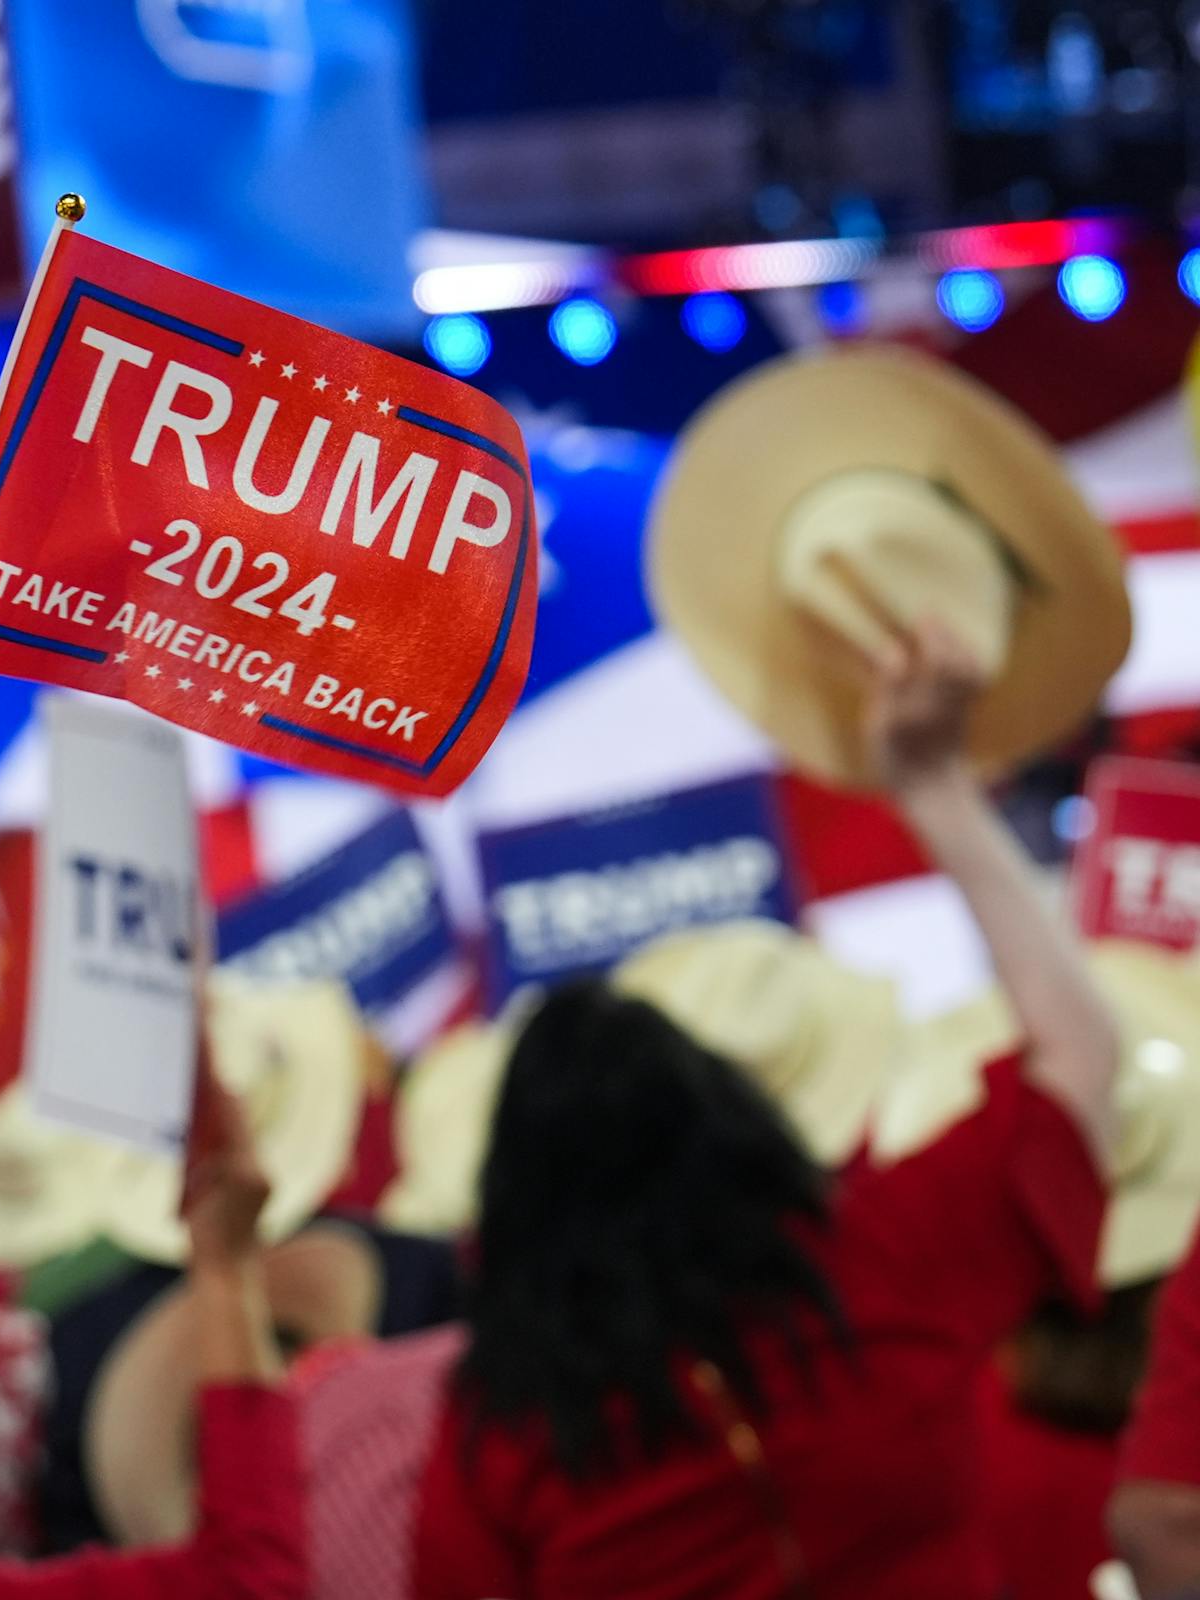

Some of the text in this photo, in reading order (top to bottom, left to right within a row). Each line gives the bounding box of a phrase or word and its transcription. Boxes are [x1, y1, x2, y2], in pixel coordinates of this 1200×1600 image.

[72, 326, 512, 575] TRUMP
[128, 518, 356, 637] -2024-
[106, 600, 295, 696] AMERICA
[304, 673, 430, 742] BACK
